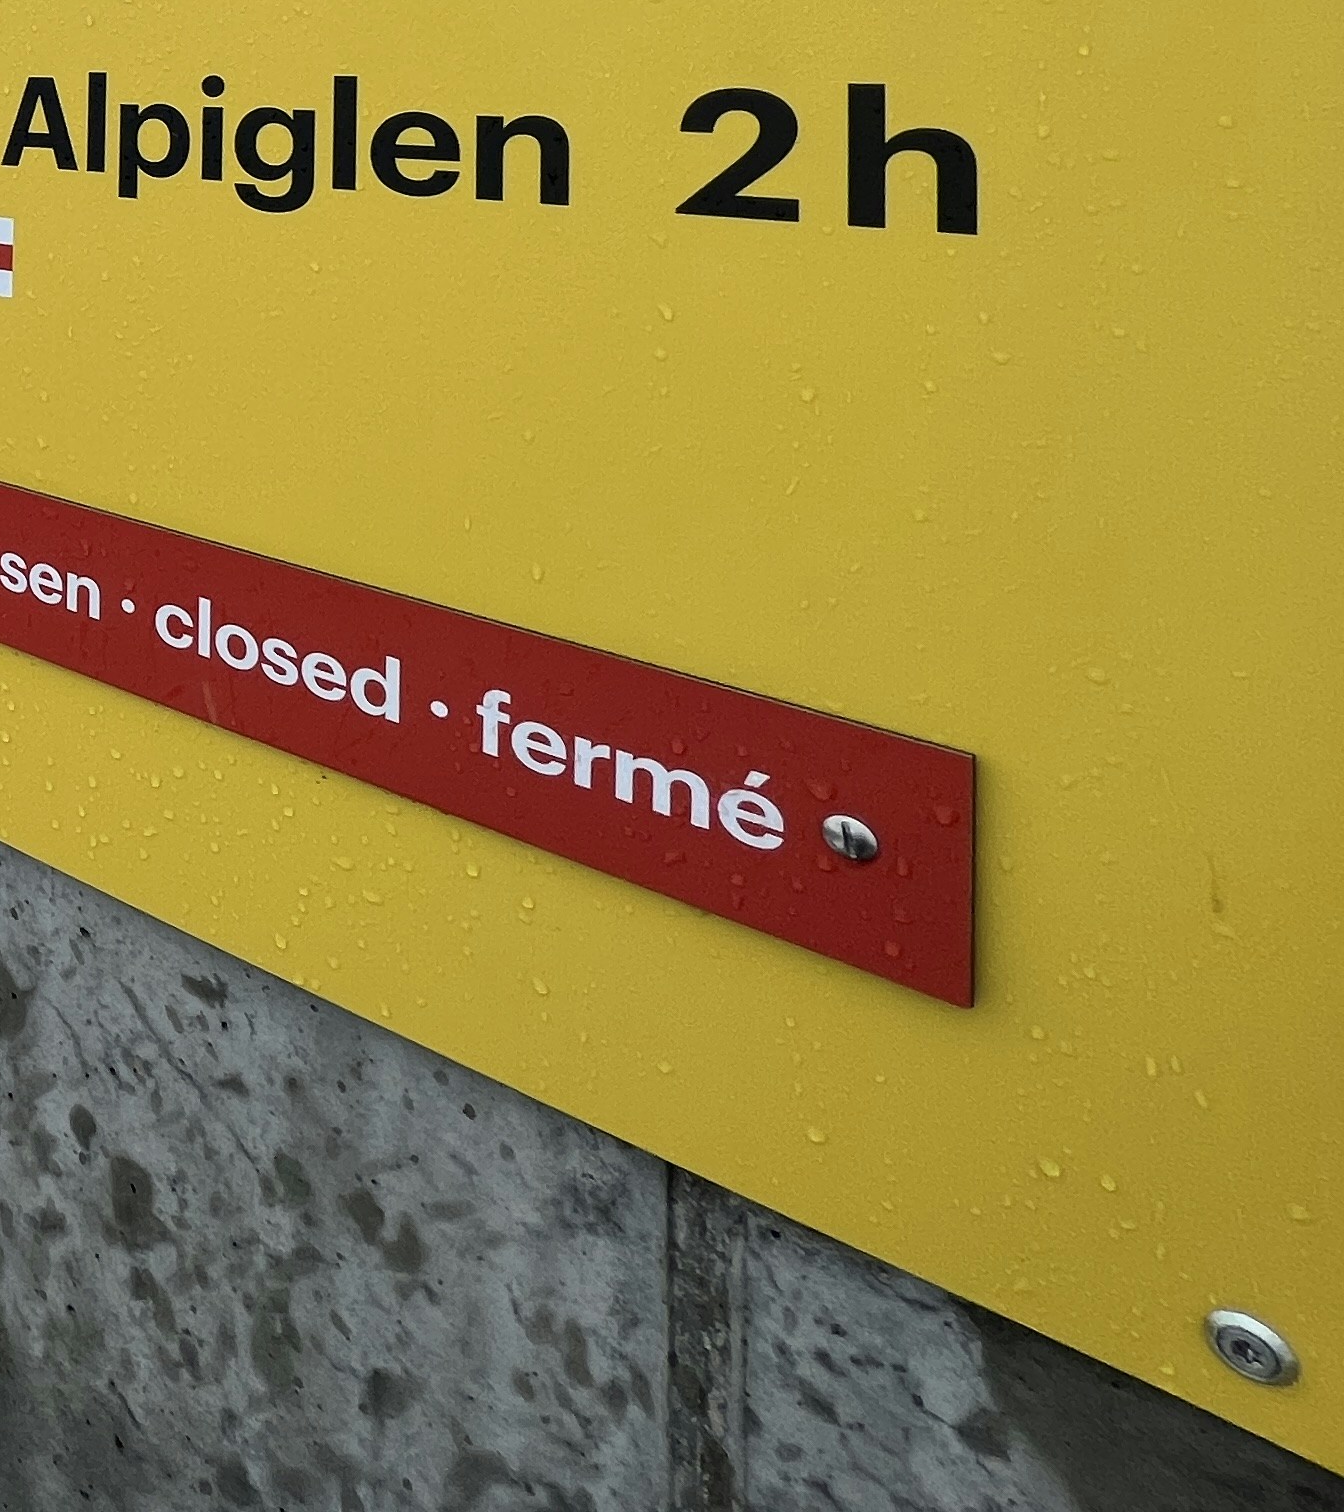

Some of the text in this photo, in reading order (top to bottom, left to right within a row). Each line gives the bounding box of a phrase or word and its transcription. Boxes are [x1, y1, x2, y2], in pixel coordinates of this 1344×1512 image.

[0, 71, 570, 214] Alpiglen
[155, 596, 402, 724] closed
[475, 689, 786, 851] fermé
